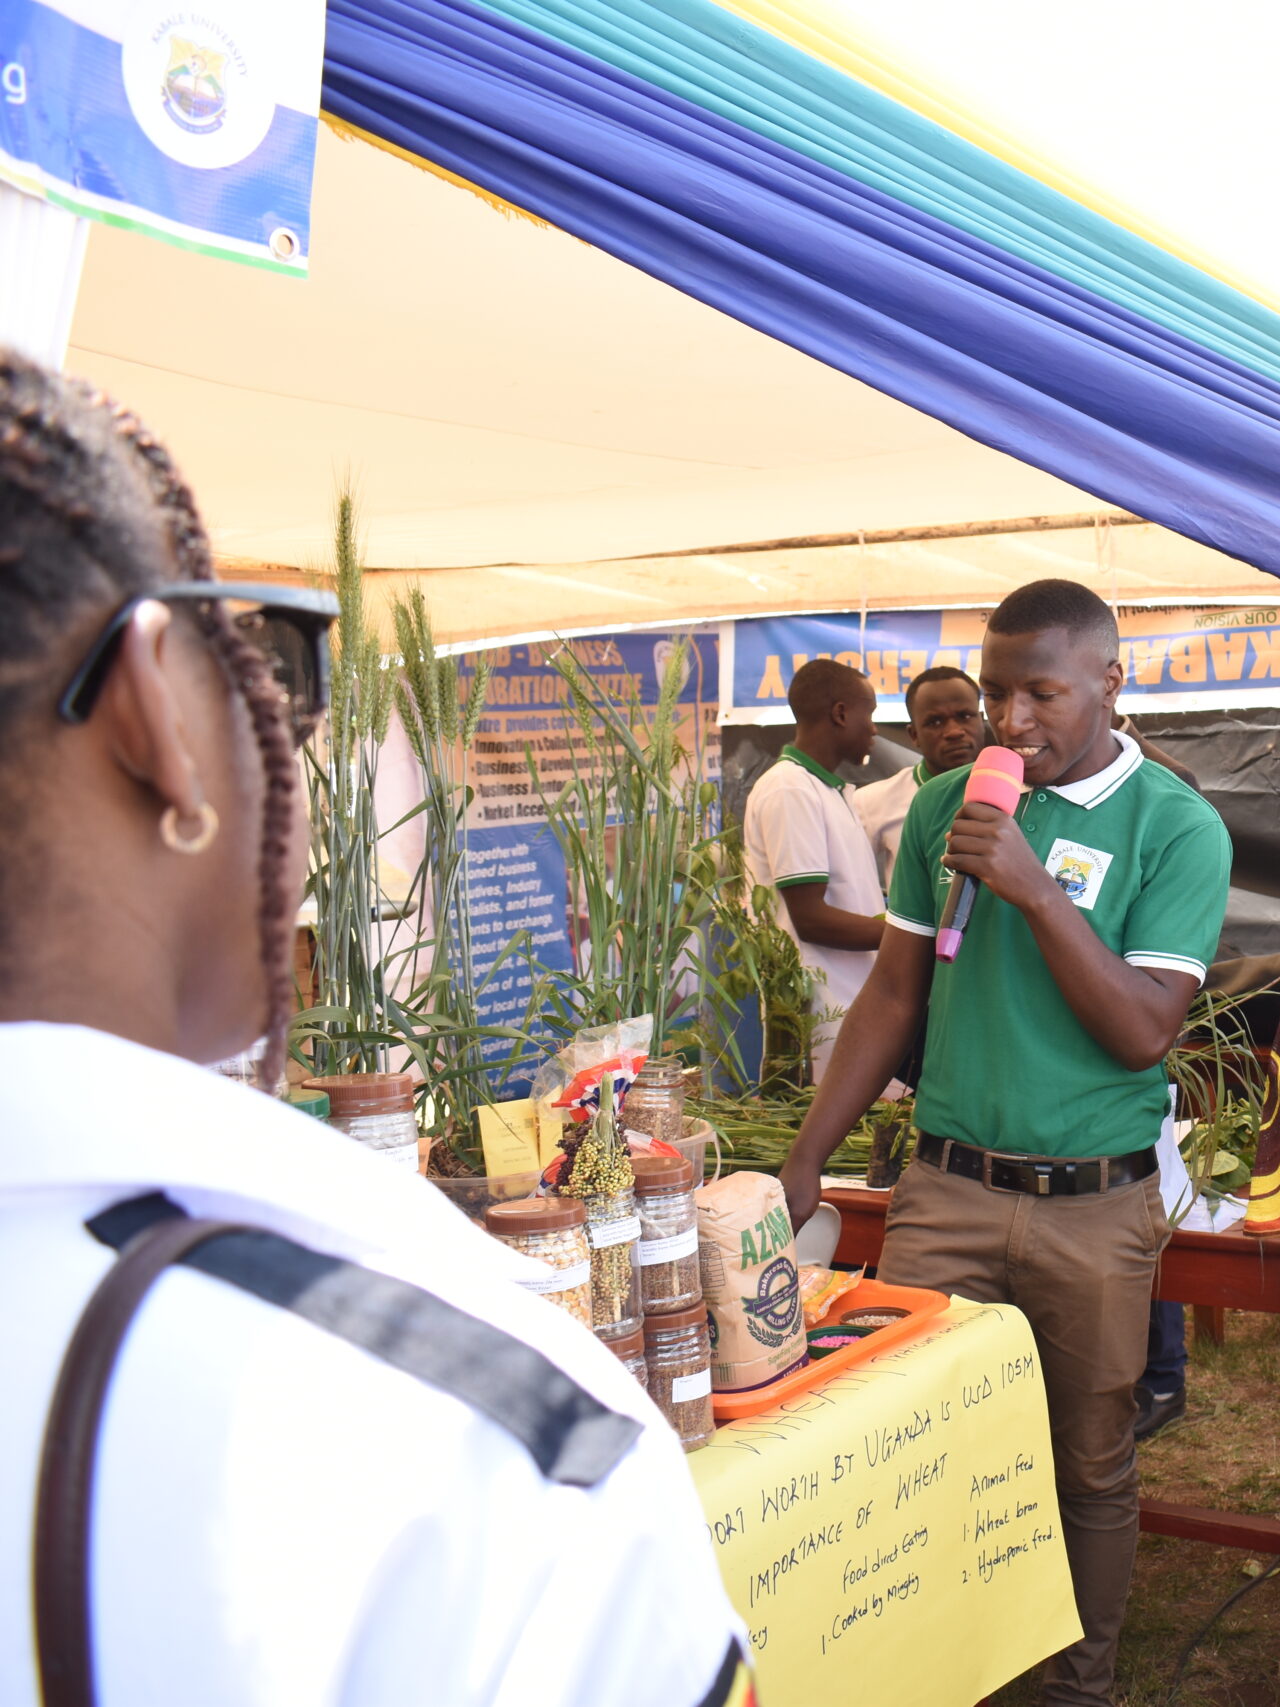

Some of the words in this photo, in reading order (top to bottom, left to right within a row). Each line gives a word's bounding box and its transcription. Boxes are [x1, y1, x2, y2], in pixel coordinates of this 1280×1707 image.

[1193, 613, 1244, 629] VISION
[1245, 610, 1278, 625] OUR
[528, 640, 624, 668] BUNESS
[457, 673, 568, 705] INBATION
[574, 672, 643, 702] ENTRE
[516, 798, 552, 817] Acce
[467, 845, 510, 863] ogether
[498, 861, 538, 877] business
[506, 898, 528, 912] and
[493, 920, 504, 933] to
[493, 997, 517, 1013] local
[740, 1205, 793, 1271] AZAM
[706, 1506, 745, 1545] ORT
[761, 1470, 819, 1523] WORTH
[864, 1409, 932, 1468] UGANDA
[941, 1401, 951, 1421] IS
[962, 1374, 993, 1409] USD
[1001, 1352, 1035, 1389] 105M
[969, 1465, 1010, 1502] Animal
[1015, 1500, 1038, 1519] bran
[750, 1521, 843, 1608] IMPORTANCE
[855, 1500, 874, 1529] OF
[895, 1452, 948, 1510] WHEAT
[978, 1537, 1029, 1584] Hydroponic
[832, 1597, 868, 1639] Cooked
[872, 1593, 883, 1617] by
